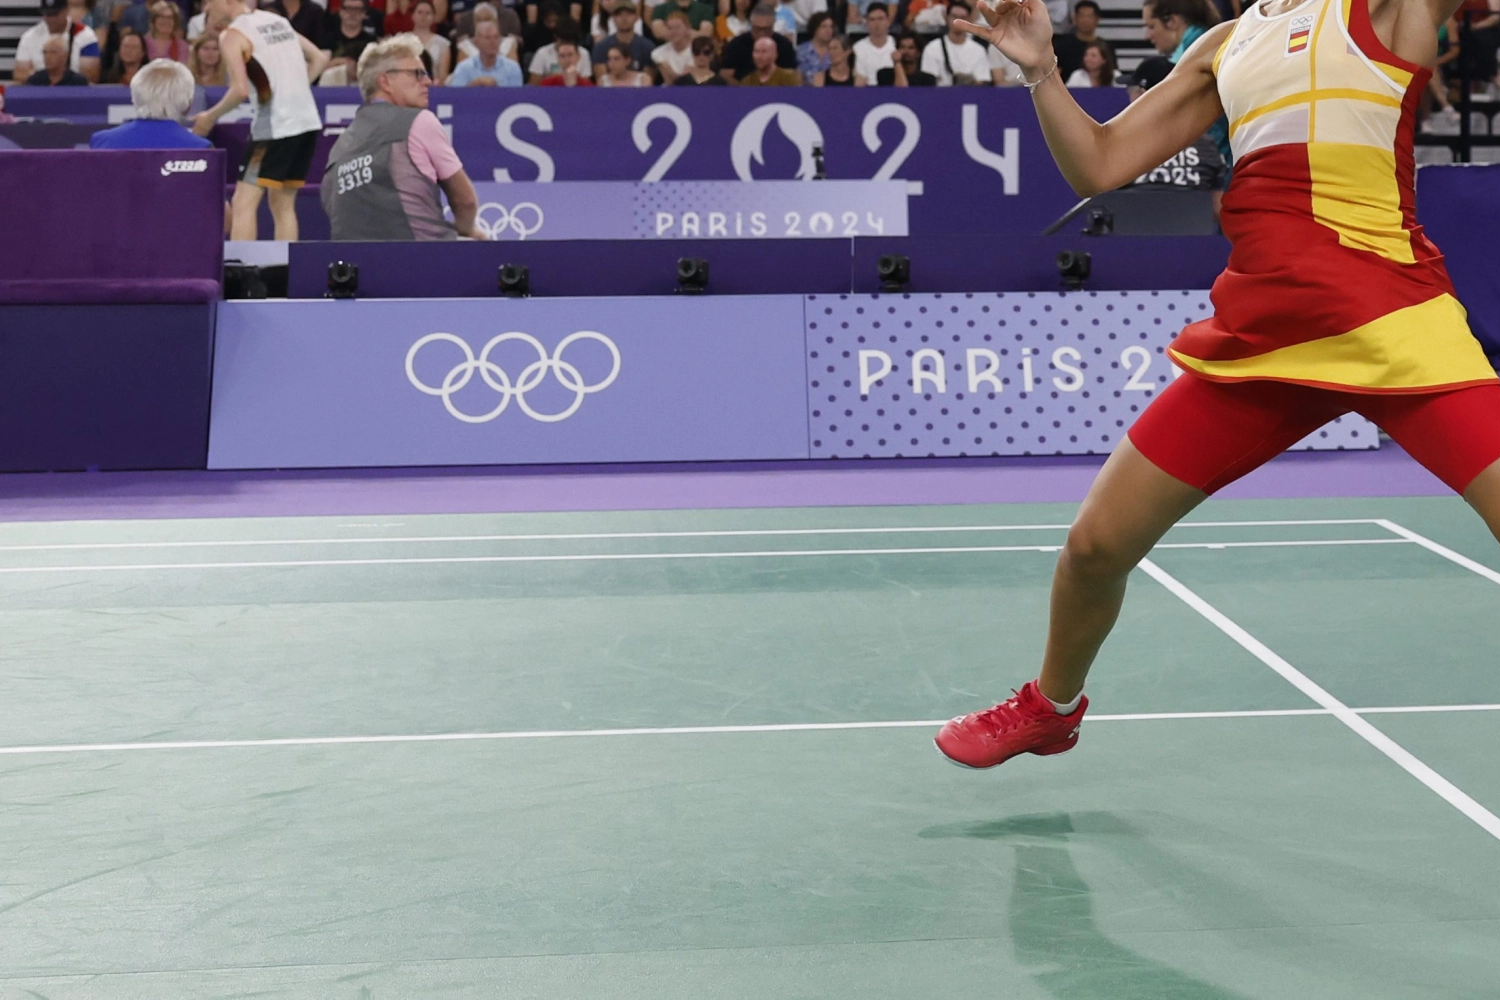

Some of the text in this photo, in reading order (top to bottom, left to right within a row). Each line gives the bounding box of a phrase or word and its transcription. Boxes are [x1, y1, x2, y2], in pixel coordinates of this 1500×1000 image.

[338, 154, 373, 177] PHOTO
[338, 166, 373, 195] 3319
[784, 210, 885, 237] 2024
